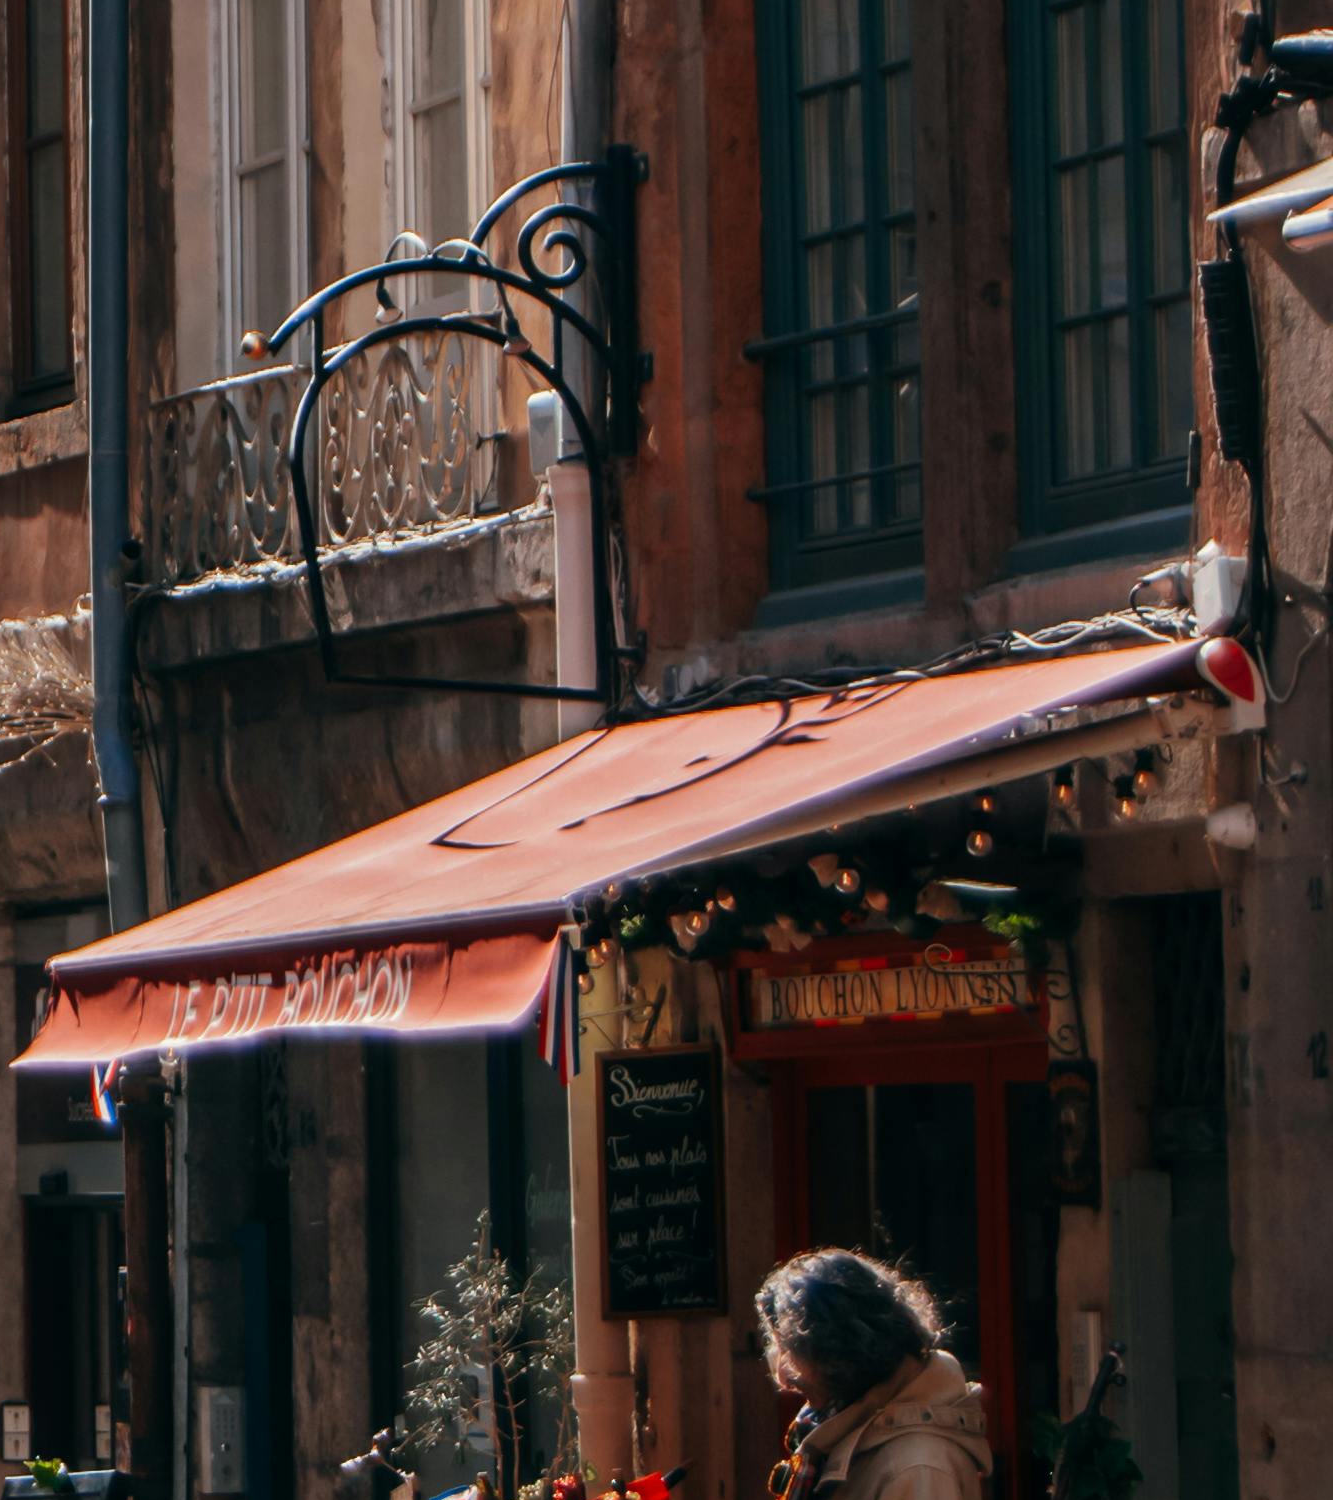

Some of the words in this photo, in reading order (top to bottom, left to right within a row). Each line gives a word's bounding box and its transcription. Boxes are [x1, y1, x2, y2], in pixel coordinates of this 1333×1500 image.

[161, 980, 201, 1042] LE
[198, 972, 273, 1040] P'TIT
[274, 953, 413, 1026] BOUCHON
[770, 972, 883, 1020] BOUCHON
[645, 1150, 666, 1166] nos
